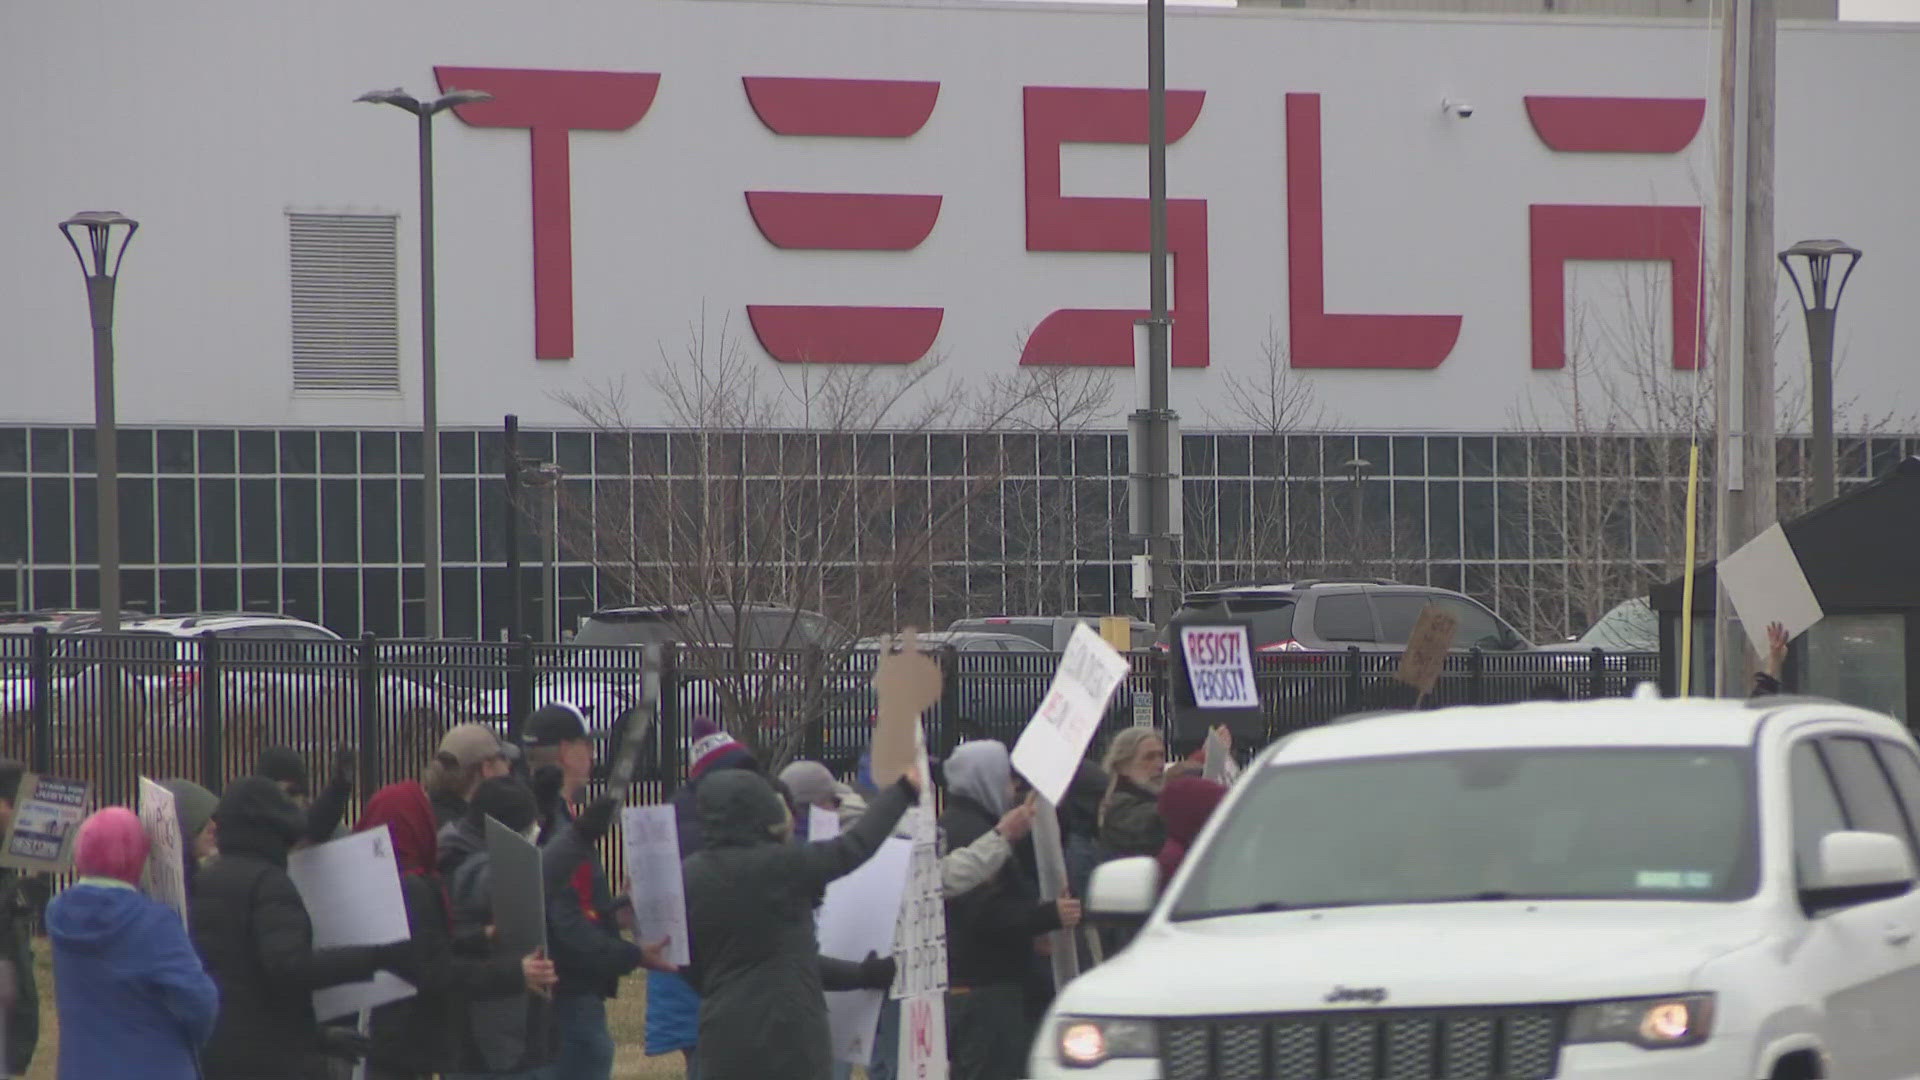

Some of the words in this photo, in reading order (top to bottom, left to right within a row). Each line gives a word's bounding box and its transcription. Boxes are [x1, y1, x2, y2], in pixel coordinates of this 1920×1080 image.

[434, 66, 1706, 369] TESLA
[1187, 632, 1240, 665] RESIST!
[1194, 668, 1247, 701] PERSIST!
[34, 791, 82, 803] JUSTICE
[1325, 985, 1386, 1004] Jeep
